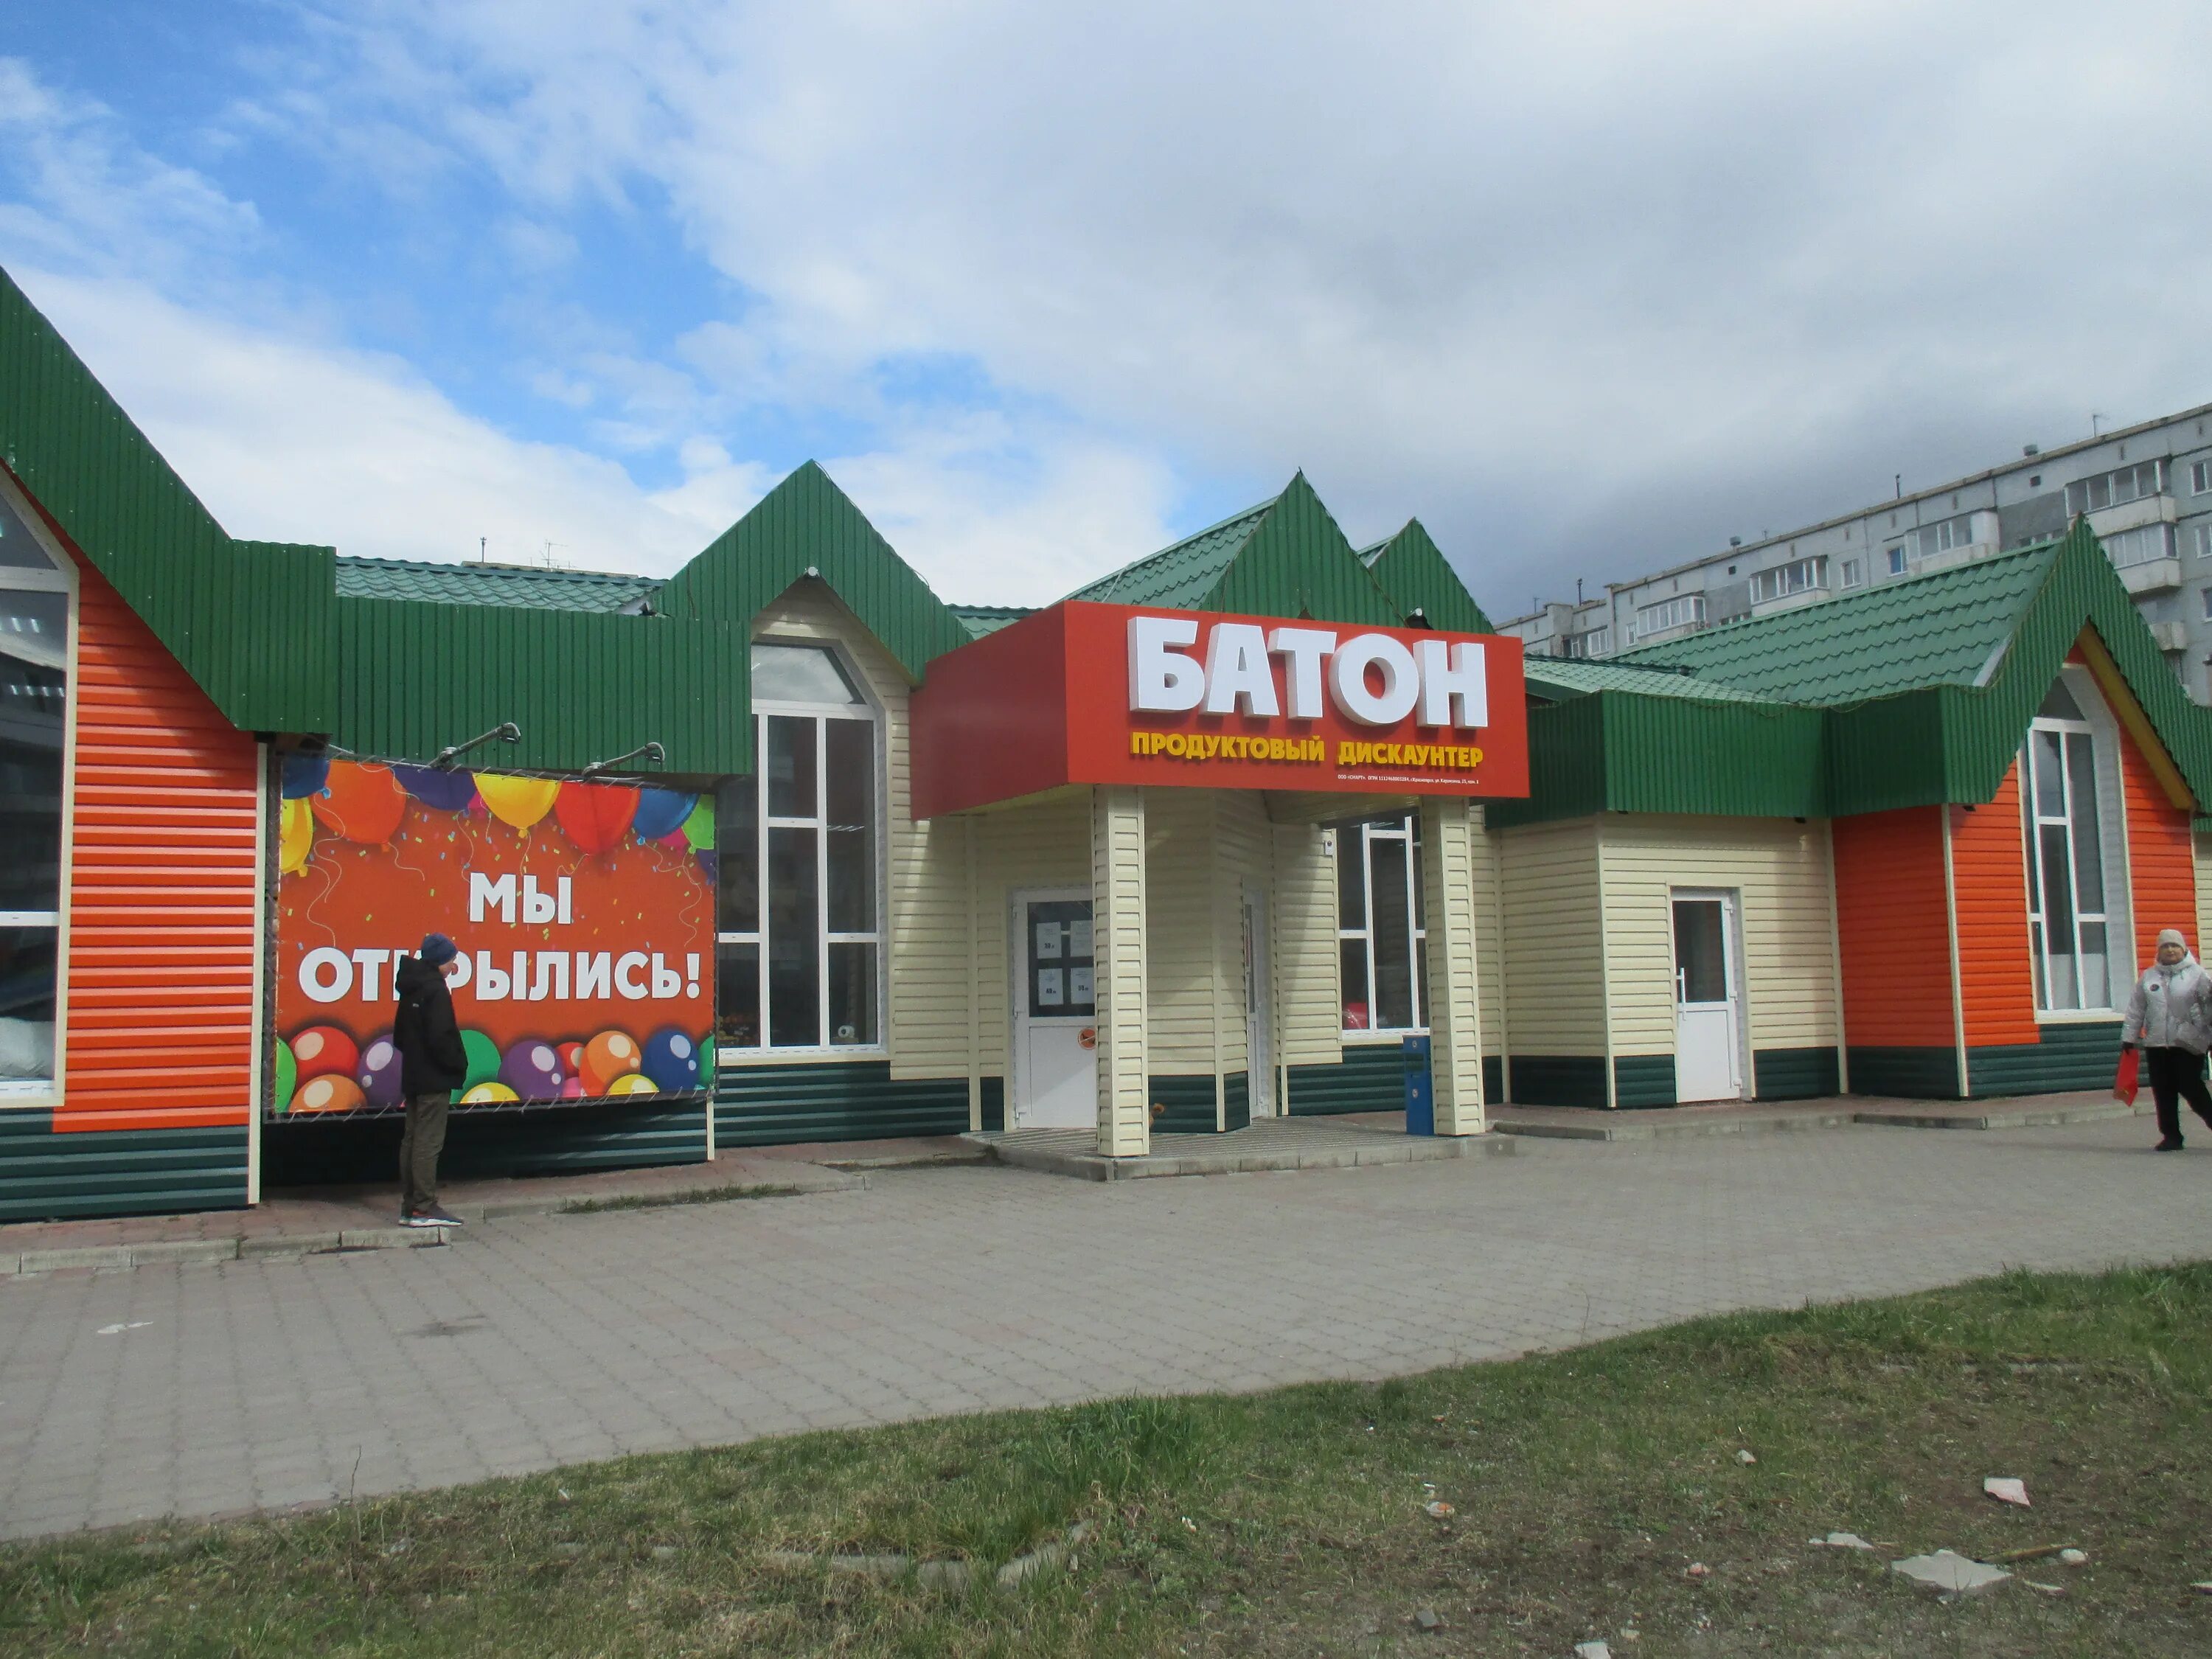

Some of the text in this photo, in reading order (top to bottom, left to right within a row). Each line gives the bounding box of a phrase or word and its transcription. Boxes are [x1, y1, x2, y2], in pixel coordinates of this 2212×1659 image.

[1127, 616, 1488, 730] БАТОН
[1130, 731, 1484, 769] ПРОДУКТОВЫЙ ДИСКАУНТЕР
[468, 872, 572, 925] МЫ
